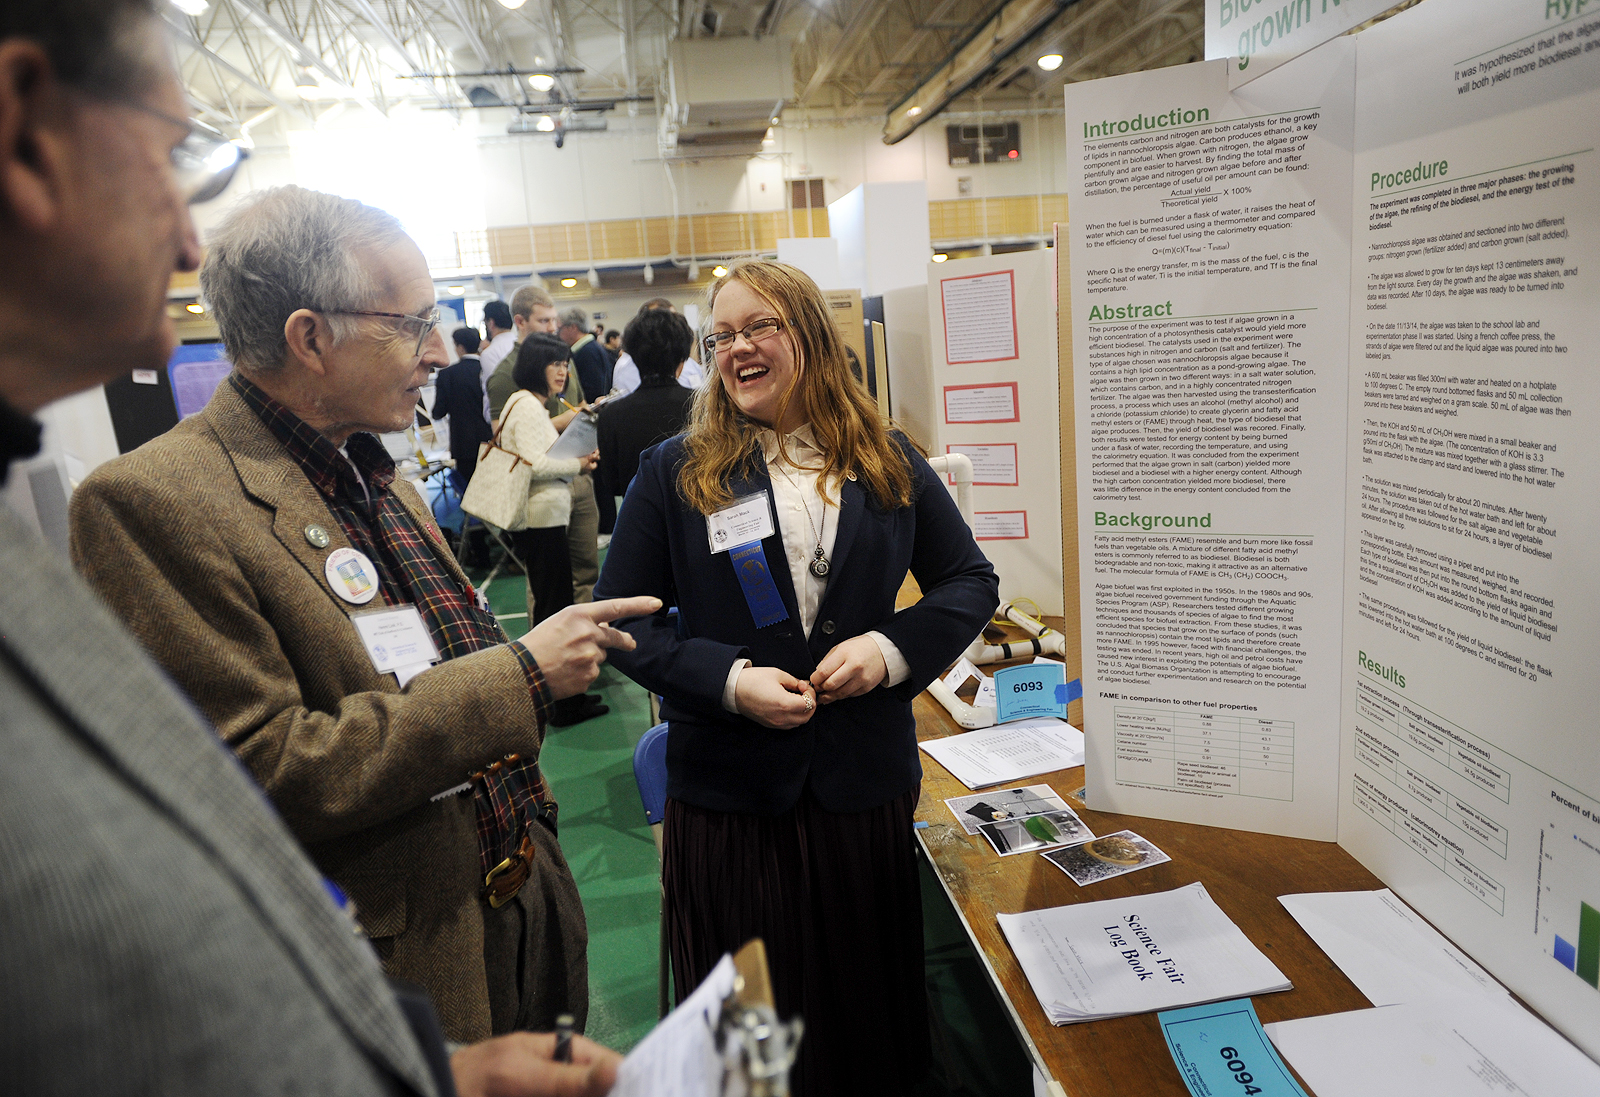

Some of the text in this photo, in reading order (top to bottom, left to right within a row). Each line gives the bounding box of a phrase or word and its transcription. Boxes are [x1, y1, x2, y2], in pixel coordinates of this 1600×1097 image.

[1238, 0, 1311, 71] grown
[1454, 71, 1459, 80] It
[1461, 66, 1476, 77] was
[1478, 44, 1535, 72] hypothesized
[1537, 37, 1555, 51] that
[1557, 32, 1574, 44] the
[1458, 82, 1470, 94] will
[1471, 76, 1489, 90] both
[1491, 70, 1511, 86] yield
[1512, 62, 1536, 76] more
[1538, 43, 1581, 67] biodiesel
[1084, 107, 1210, 138] Introduction
[1084, 143, 1096, 151] The
[1097, 140, 1128, 149] elements
[1129, 136, 1153, 145] carbon
[1155, 133, 1168, 141] and
[1170, 130, 1199, 139] nitrogen
[1214, 124, 1230, 133] both
[1232, 121, 1265, 131] catalysts
[1279, 116, 1291, 124] the
[1293, 112, 1320, 124] growth
[1091, 151, 1108, 161] lipids
[1118, 142, 1173, 156] nannochloropsis
[1175, 141, 1196, 149] algae.
[1199, 136, 1225, 145] Carbon
[1227, 132, 1261, 143] produces
[1263, 126, 1293, 137] ethanol,
[1303, 124, 1317, 132] key
[1171, 186, 1211, 196] Actual yield
[1370, 160, 1448, 191] Procedure
[1370, 202, 1379, 210] The
[1379, 196, 1408, 209] experiment
[1421, 187, 1451, 200] completed
[1452, 186, 1459, 194] in
[1460, 184, 1476, 192] three
[1477, 179, 1496, 189] major
[1498, 172, 1526, 187] phases:
[1528, 170, 1540, 179] the
[1541, 165, 1574, 179] growing
[1161, 195, 1218, 208] Theoretical yield
[1088, 300, 1172, 321] Abstract
[1102, 325, 1128, 334] purpose
[1150, 321, 1188, 330] experiment
[1234, 317, 1254, 325] algae
[1256, 316, 1279, 324] grown
[1370, 322, 1376, 330] On
[1396, 322, 1418, 330] 11/13/14,
[1429, 321, 1443, 331] algae
[1481, 320, 1491, 328] the
[1492, 320, 1513, 328] school
[1514, 320, 1525, 328] lab
[1526, 319, 1540, 328] and
[1088, 334, 1102, 342] high
[1103, 332, 1147, 340] concentration
[1148, 330, 1155, 338] of
[1163, 327, 1214, 338] photosynthesis
[1216, 326, 1243, 334] catalyst
[1244, 324, 1266, 332] would
[1268, 323, 1285, 332] yield
[1094, 512, 1212, 530] Background
[1094, 535, 1109, 544] Fatty
[1125, 536, 1146, 544] methyl
[1169, 536, 1194, 545] (FAME)
[1358, 650, 1406, 689] Results
[1013, 681, 1043, 693] 6093
[1100, 692, 1119, 700] FAME
[1129, 696, 1171, 704] comparison
[1219, 703, 1257, 711] properties
[1363, 684, 1382, 697] extraction
[1383, 694, 1399, 707] process
[1402, 704, 1422, 721] (Through
[1423, 717, 1466, 745] transesterification
[1467, 742, 1490, 761] process)
[1363, 731, 1382, 746] extraction
[1382, 743, 1399, 756] process
[1551, 790, 1580, 813] Percent
[1582, 810, 1590, 818] of
[1103, 925, 1153, 981] Log Book
[1123, 914, 1185, 984] Science Fair
[1175, 1043, 1188, 1067] Science
[1190, 1062, 1212, 1096] Connecticut
[1220, 1046, 1262, 1096] 6094
